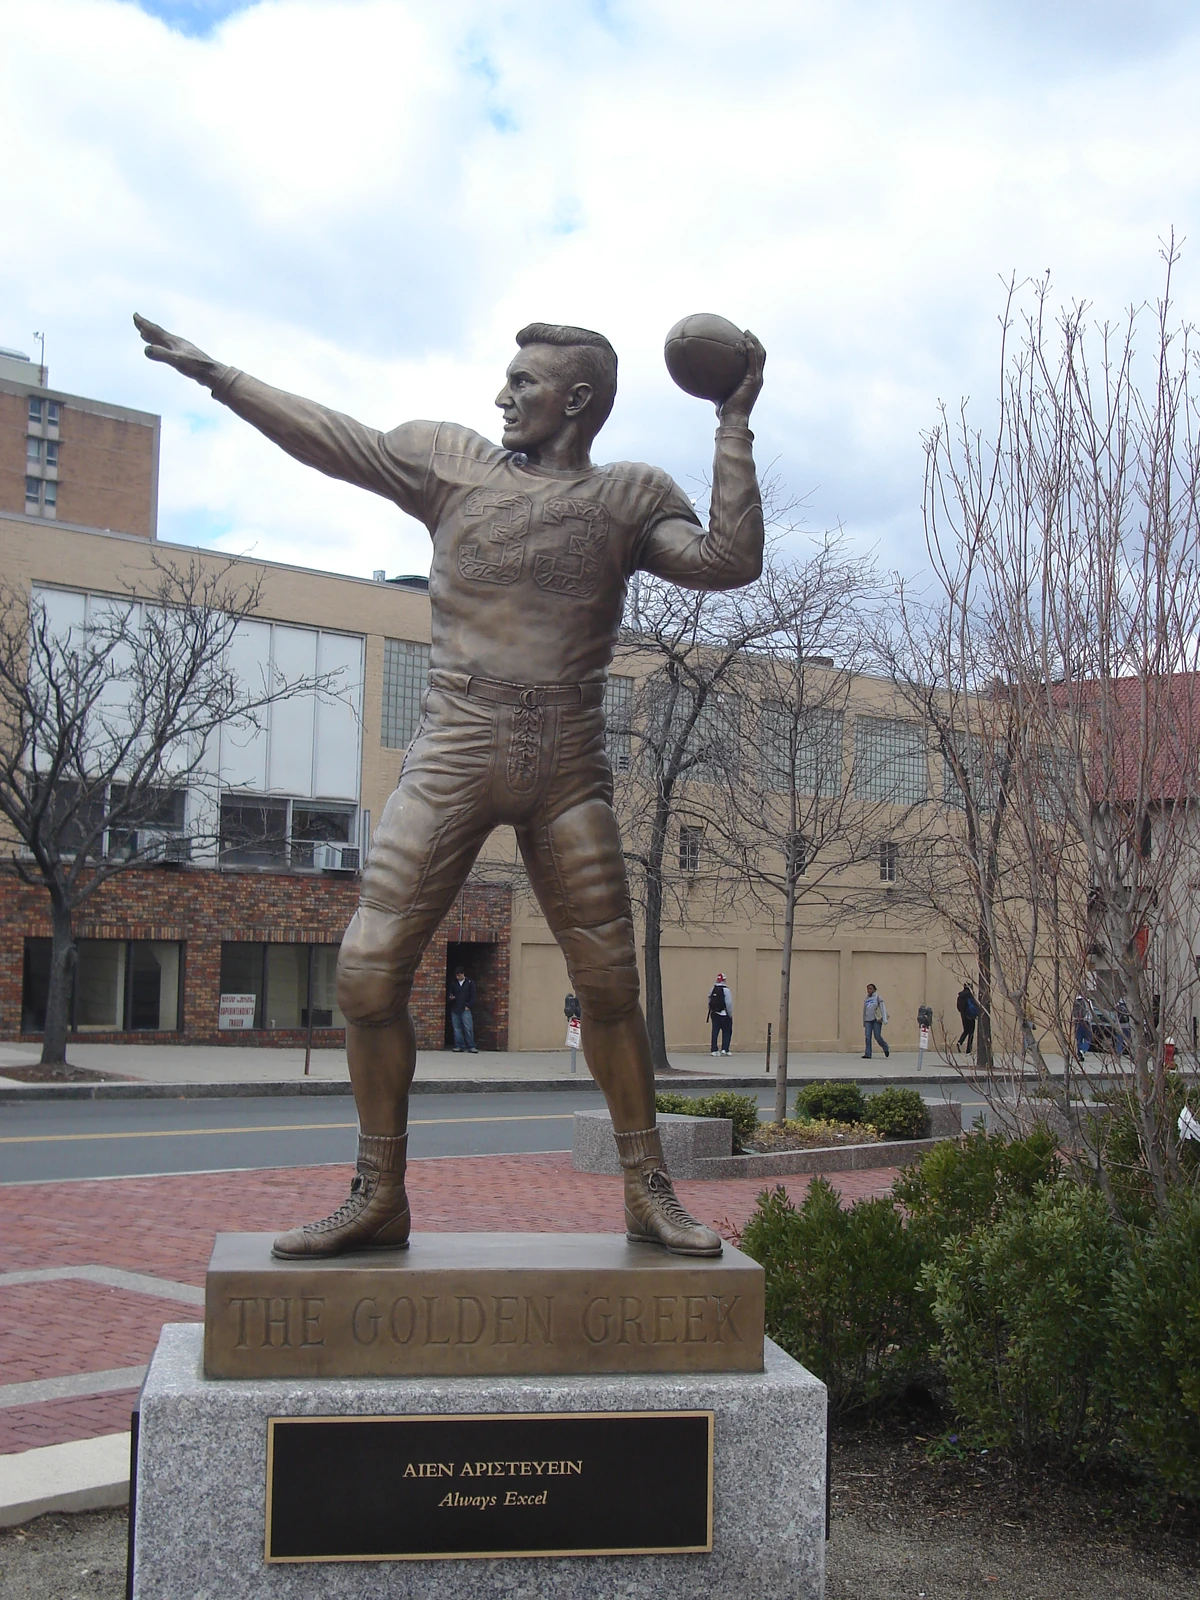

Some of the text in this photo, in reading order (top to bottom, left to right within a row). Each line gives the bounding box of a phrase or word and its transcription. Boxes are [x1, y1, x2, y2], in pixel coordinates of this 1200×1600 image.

[458, 488, 611, 599] 33
[228, 1294, 744, 1349] THE GOLDEN GREEK
[437, 1490, 548, 1511] Always Excel
